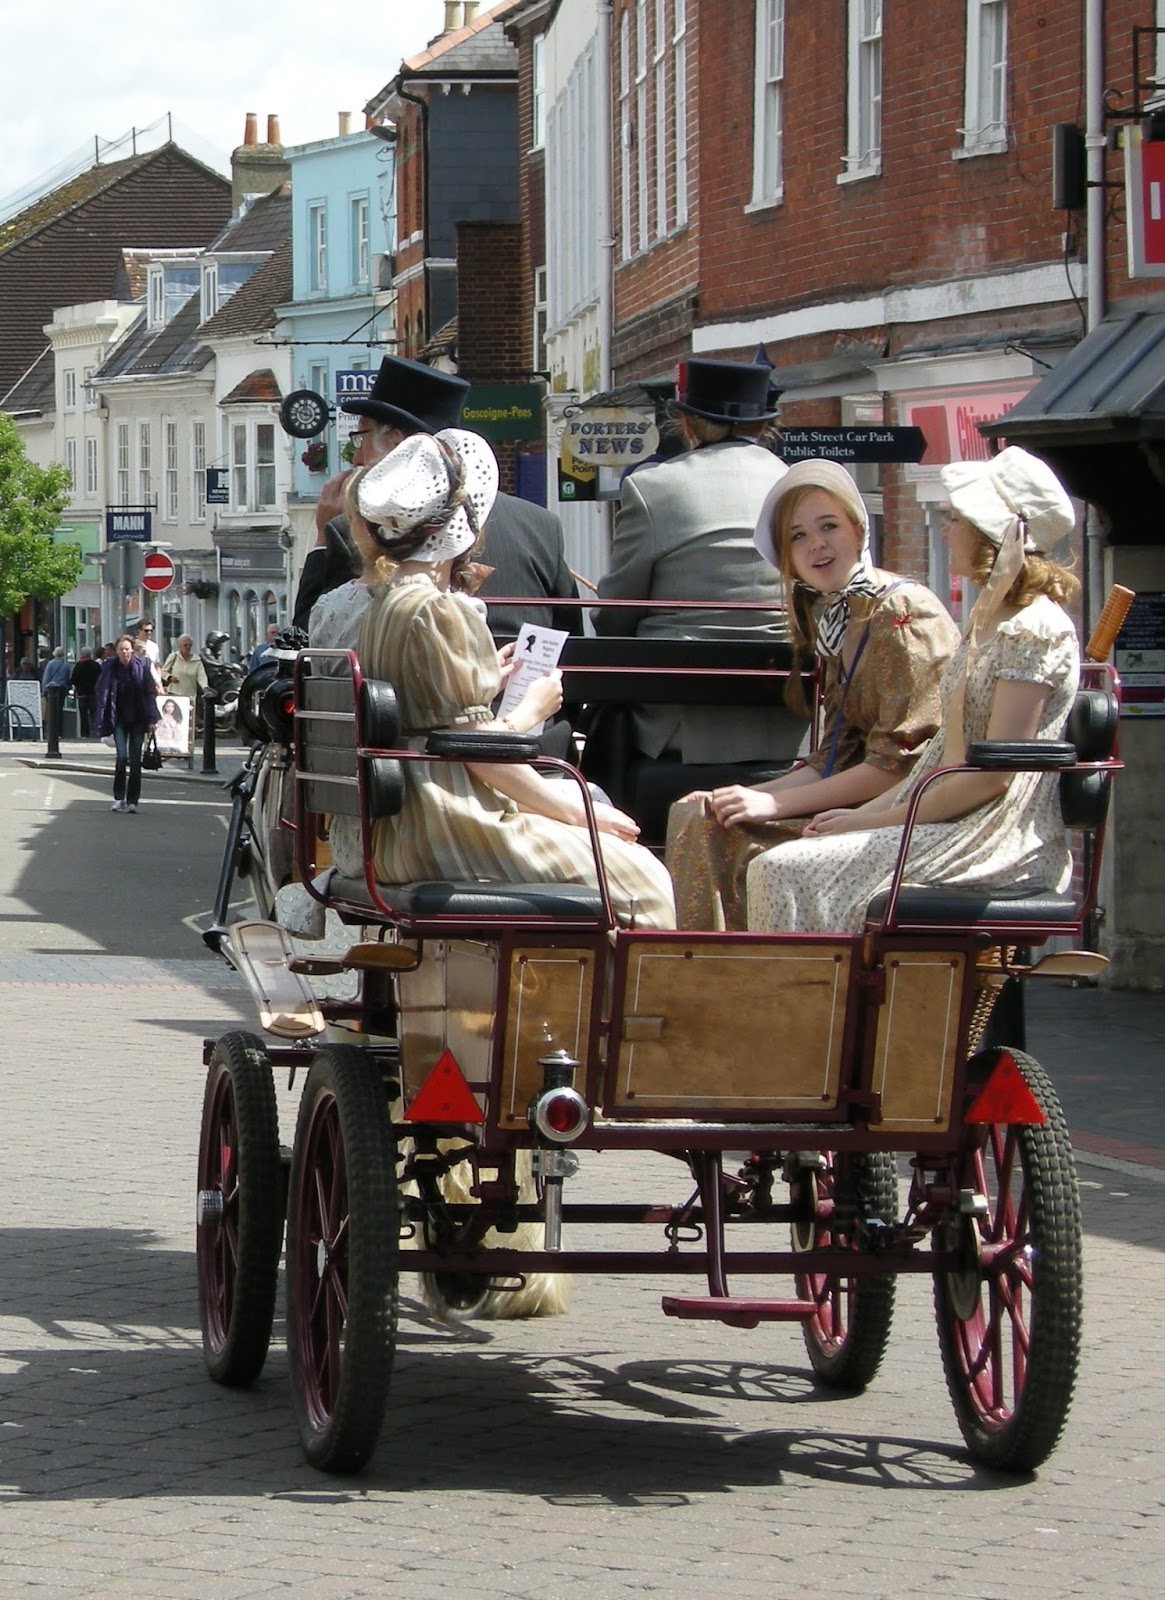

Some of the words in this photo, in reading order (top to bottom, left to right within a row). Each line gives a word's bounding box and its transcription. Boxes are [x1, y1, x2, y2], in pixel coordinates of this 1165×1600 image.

[462, 406, 532, 420] Gascoigne-Pees
[782, 431, 808, 442] Turk
[810, 431, 843, 442] Street
[846, 431, 866, 442] Car
[869, 431, 894, 442] Park
[579, 438, 644, 454] NEWS
[782, 446, 816, 457] Public
[818, 446, 855, 457] Toilets
[113, 515, 145, 531] MANN
